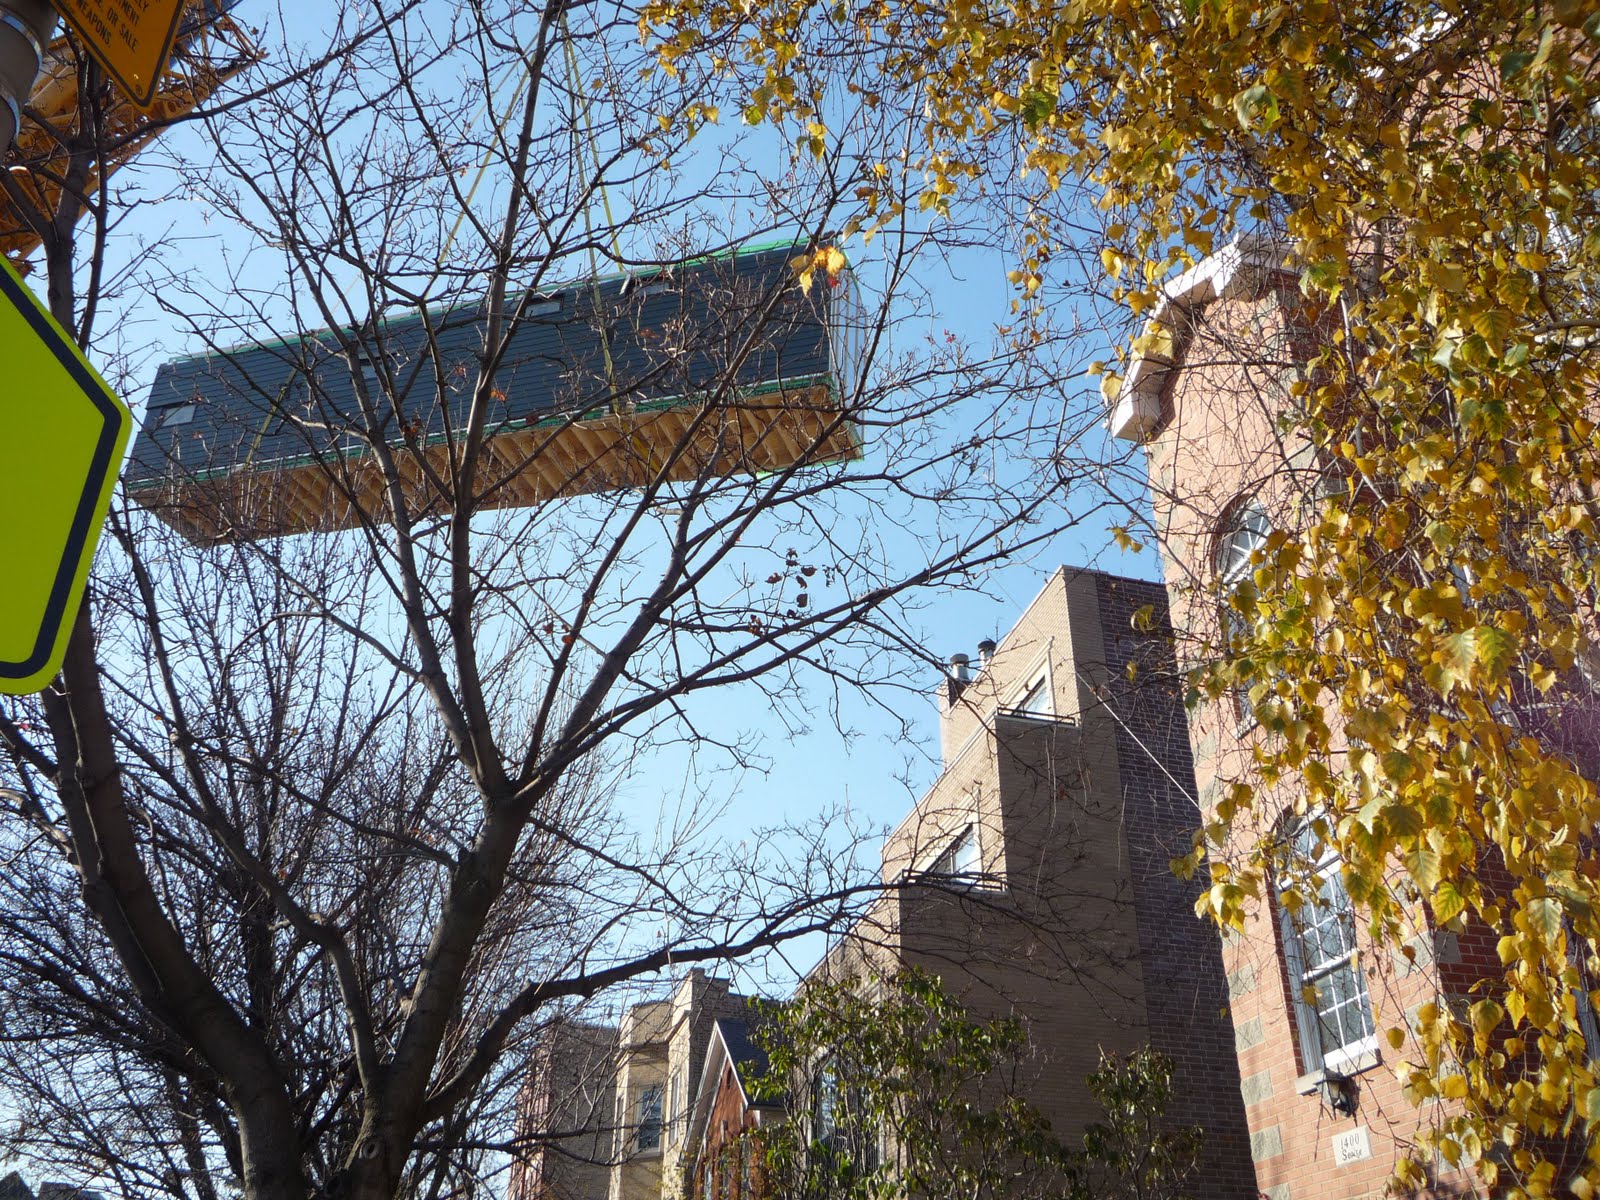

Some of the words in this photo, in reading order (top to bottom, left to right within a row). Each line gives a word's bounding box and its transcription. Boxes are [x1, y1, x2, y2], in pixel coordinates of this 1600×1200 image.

[116, 0, 140, 27] MENT
[107, 7, 119, 27] OR
[119, 23, 138, 53] SALE
[1341, 1133, 1360, 1149] 1400
